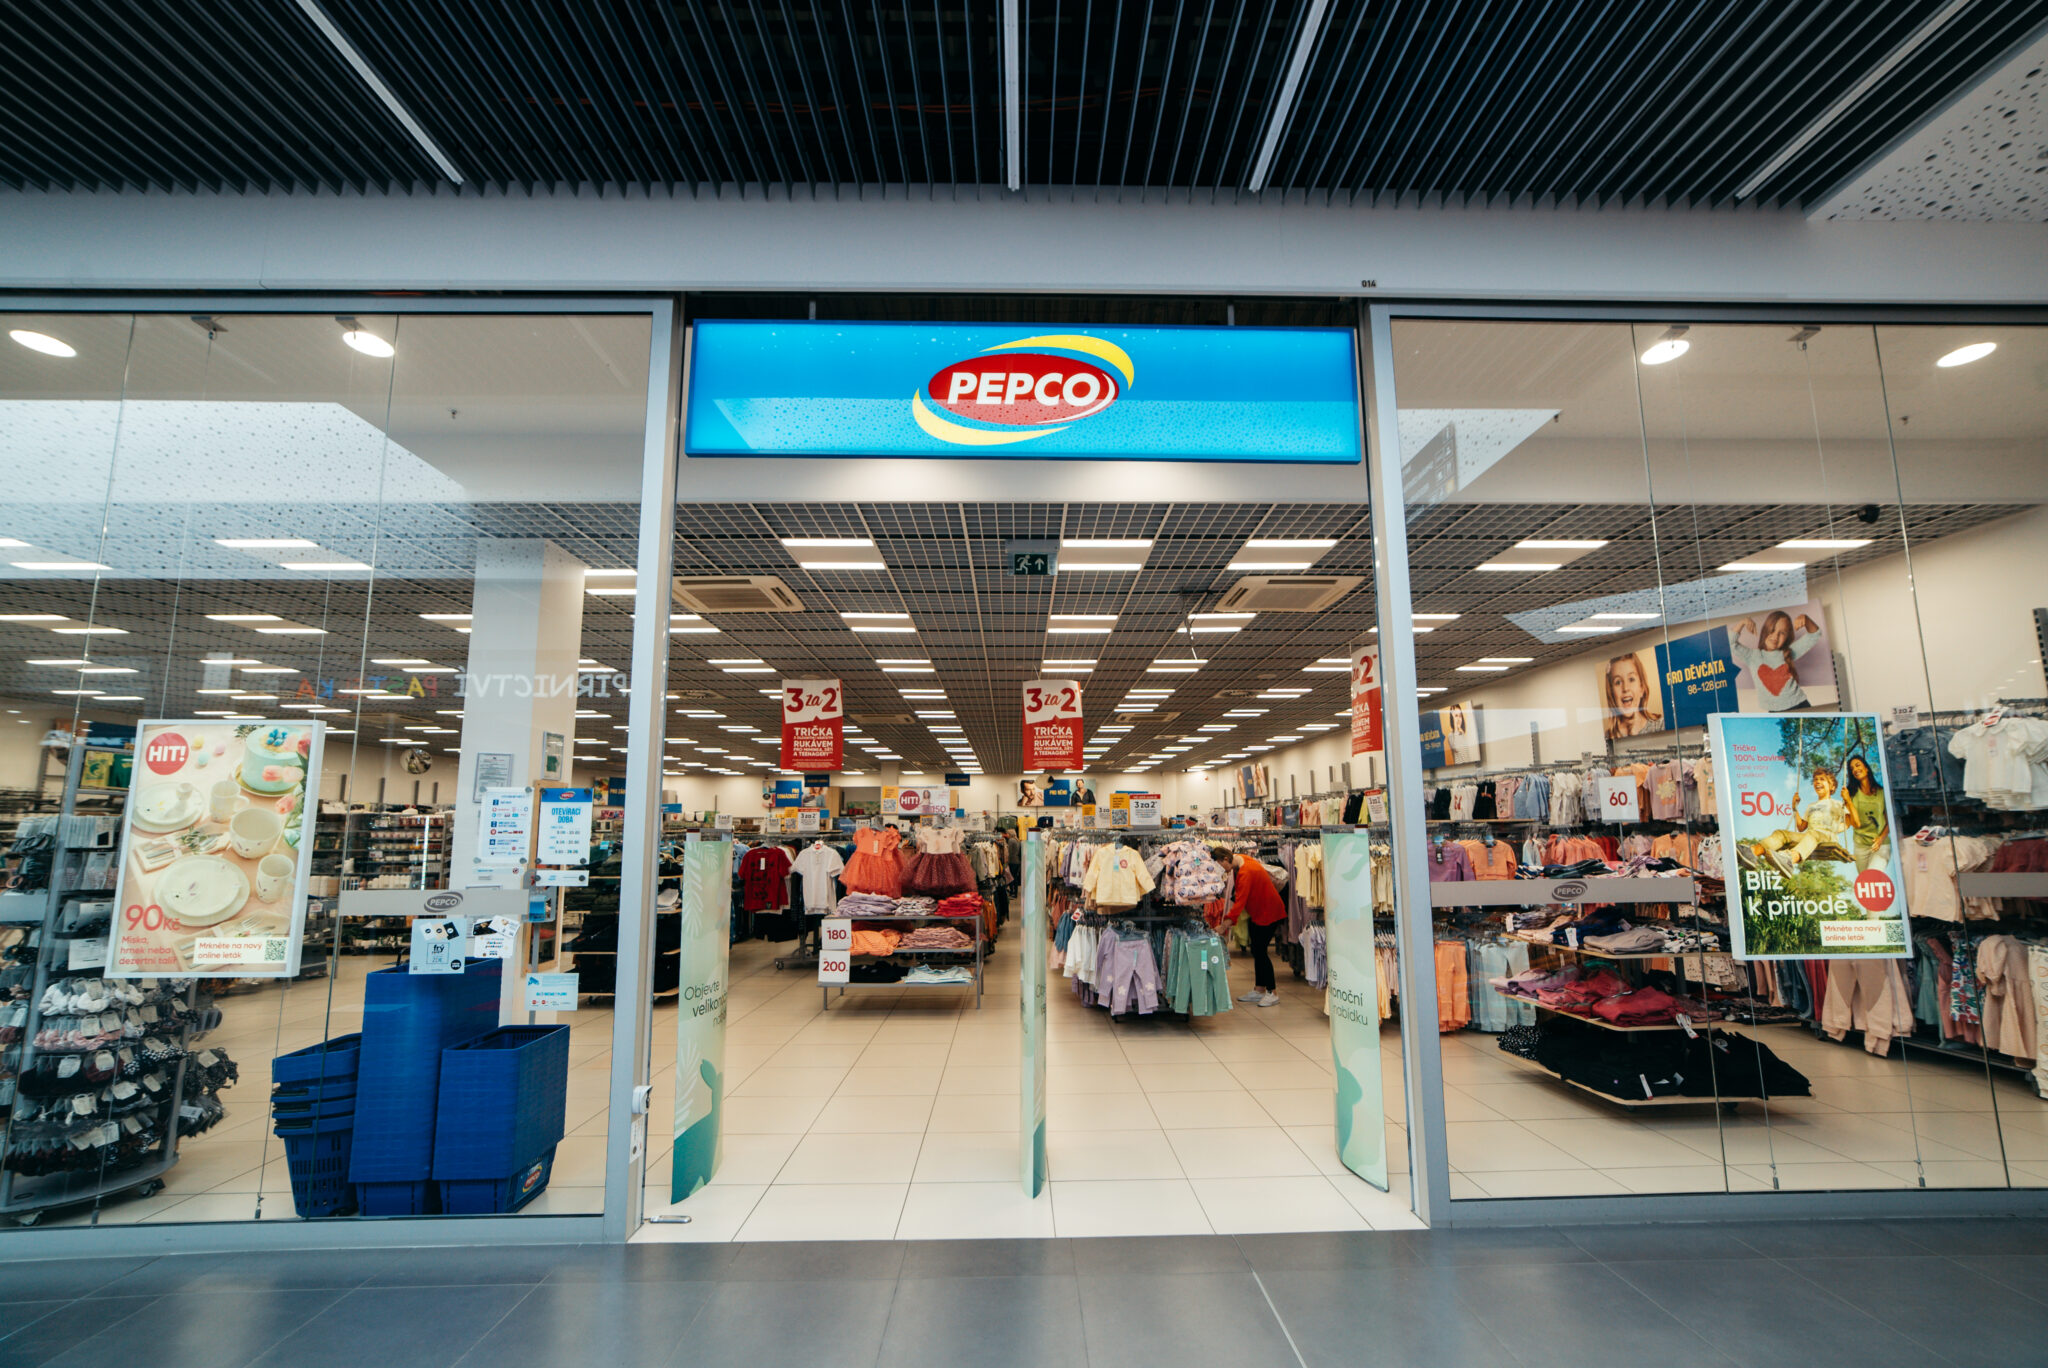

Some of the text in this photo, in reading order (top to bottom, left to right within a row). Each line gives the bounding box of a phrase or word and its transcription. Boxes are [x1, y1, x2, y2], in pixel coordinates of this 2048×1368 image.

[1361, 279, 1377, 288] 014
[947, 372, 1101, 407] PEPCO
[1684, 659, 1726, 682] DĚVČATA
[1715, 679, 1728, 689] cm
[786, 688, 804, 712] 3
[805, 694, 822, 706] za
[1026, 688, 1042, 712] 3
[1044, 694, 1060, 706] za
[794, 725, 833, 736] TRIČKA
[1034, 724, 1073, 735] TRIČKA
[794, 739, 833, 748] RUKÁVEM
[1034, 737, 1073, 747] RUKÁVEM
[148, 745, 187, 762] HIT!
[1732, 744, 1757, 752] Trička
[1734, 754, 1755, 762] 100%
[900, 796, 919, 805] HIT!
[1609, 791, 1628, 806] 60
[1741, 791, 1792, 817] 50 Kč
[1557, 886, 1583, 895] PEPCO
[1857, 881, 1894, 899] HIT!
[430, 898, 458, 906] PEPCO
[1748, 895, 1762, 917] k
[126, 904, 164, 931] 90
[826, 930, 847, 940] 180
[198, 951, 221, 959] online
[823, 961, 846, 972] 200
